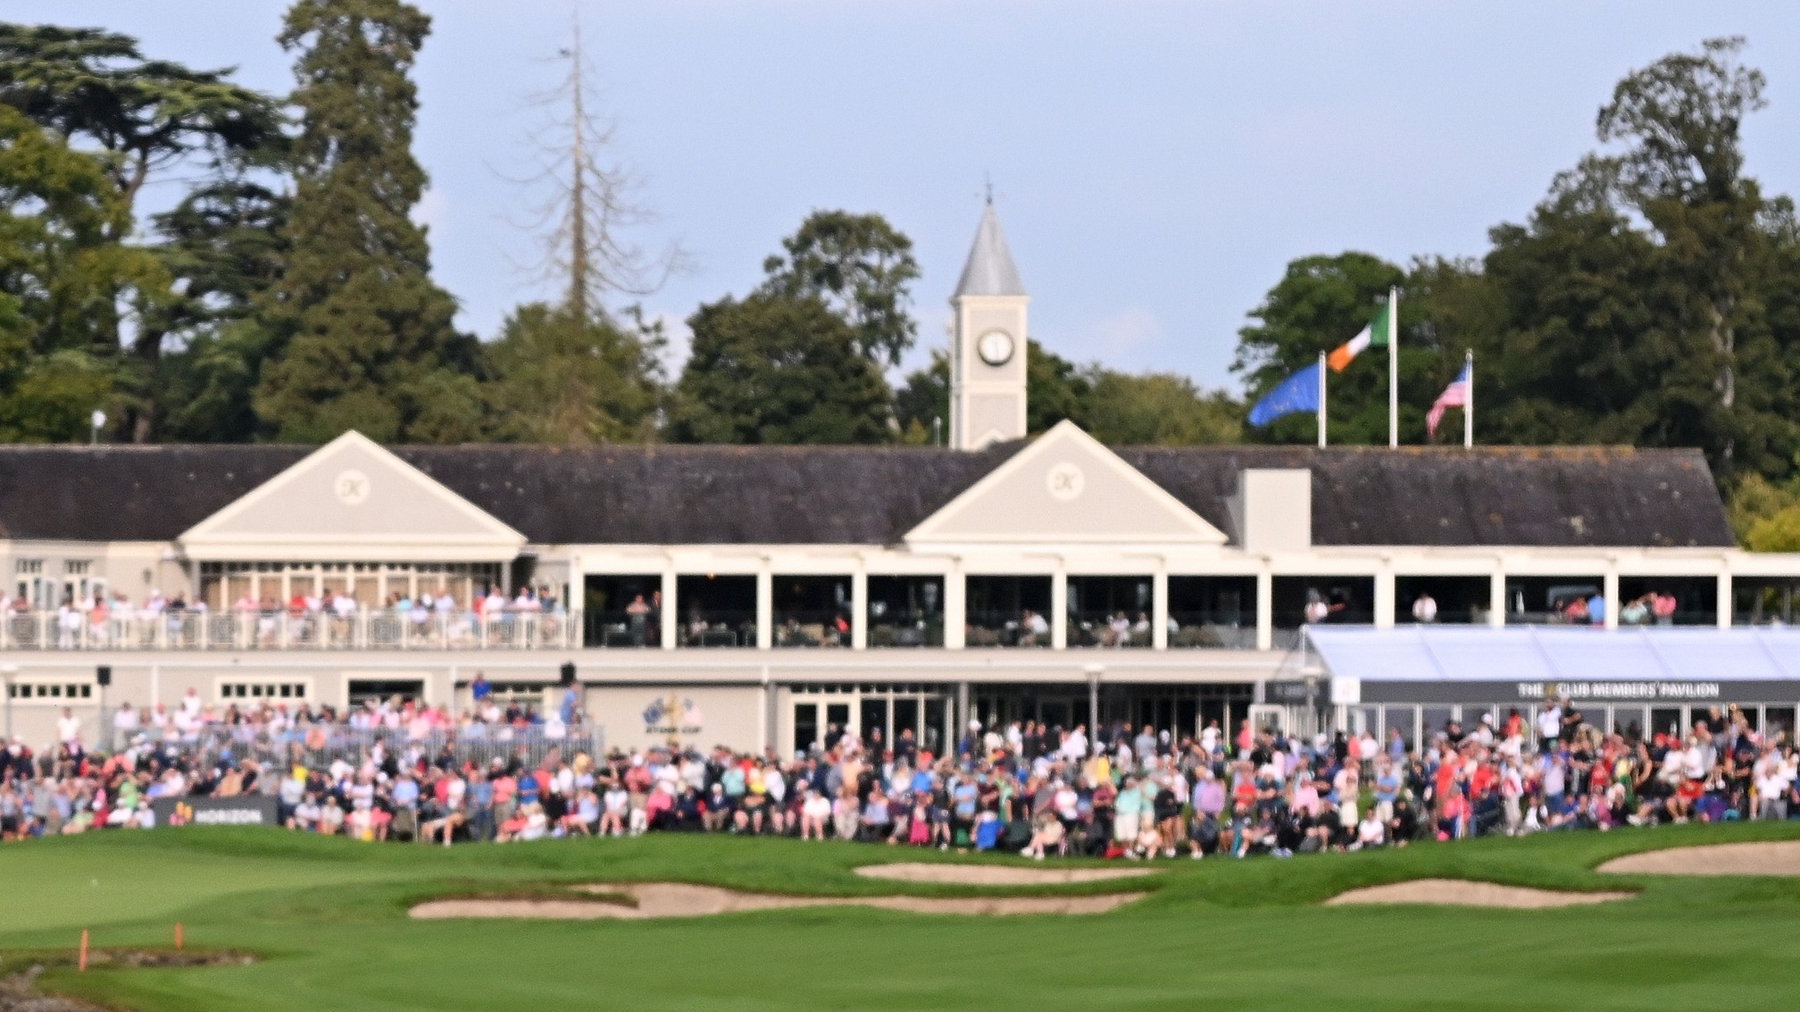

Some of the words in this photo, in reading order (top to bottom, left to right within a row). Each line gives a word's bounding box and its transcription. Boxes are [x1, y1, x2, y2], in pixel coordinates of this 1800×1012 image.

[1518, 682, 1544, 698] THE
[1659, 682, 1719, 698] PAVILION
[195, 809, 262, 824] HORIZON
